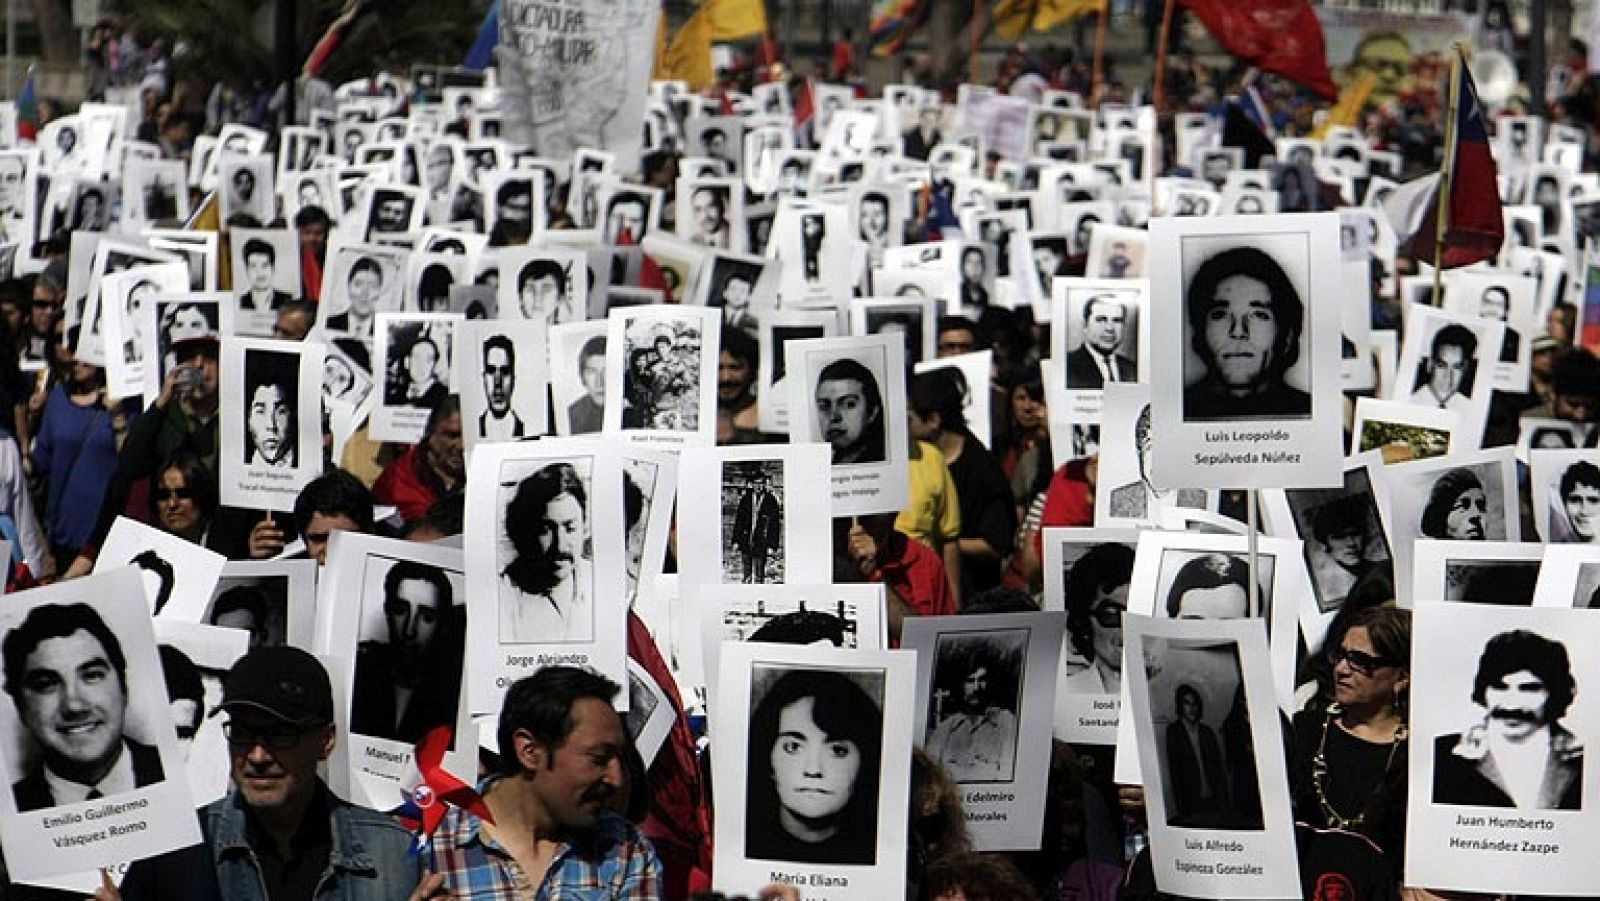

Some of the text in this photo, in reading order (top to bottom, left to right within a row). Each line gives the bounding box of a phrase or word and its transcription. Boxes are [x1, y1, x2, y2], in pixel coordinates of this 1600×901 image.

[1205, 429, 1290, 443] Luis Leopoldo
[1195, 450, 1301, 466] Sepúlveda Núñez
[831, 475, 850, 484] ergio
[506, 653, 588, 668] Jorge Alejandro
[1093, 700, 1115, 710] José
[1079, 717, 1120, 727] Santand
[365, 746, 402, 764] Manuel
[966, 792, 1015, 803] Edelmiro
[43, 798, 149, 829] Emilio Guillermo
[1456, 813, 1555, 831] Juan Humberto
[53, 821, 147, 848] Vásquez Romo
[1185, 838, 1244, 852] Luis Alfredo
[1450, 837, 1559, 855] Hernández Zazpe
[1216, 862, 1263, 875] González
[810, 873, 849, 887] Eliana
